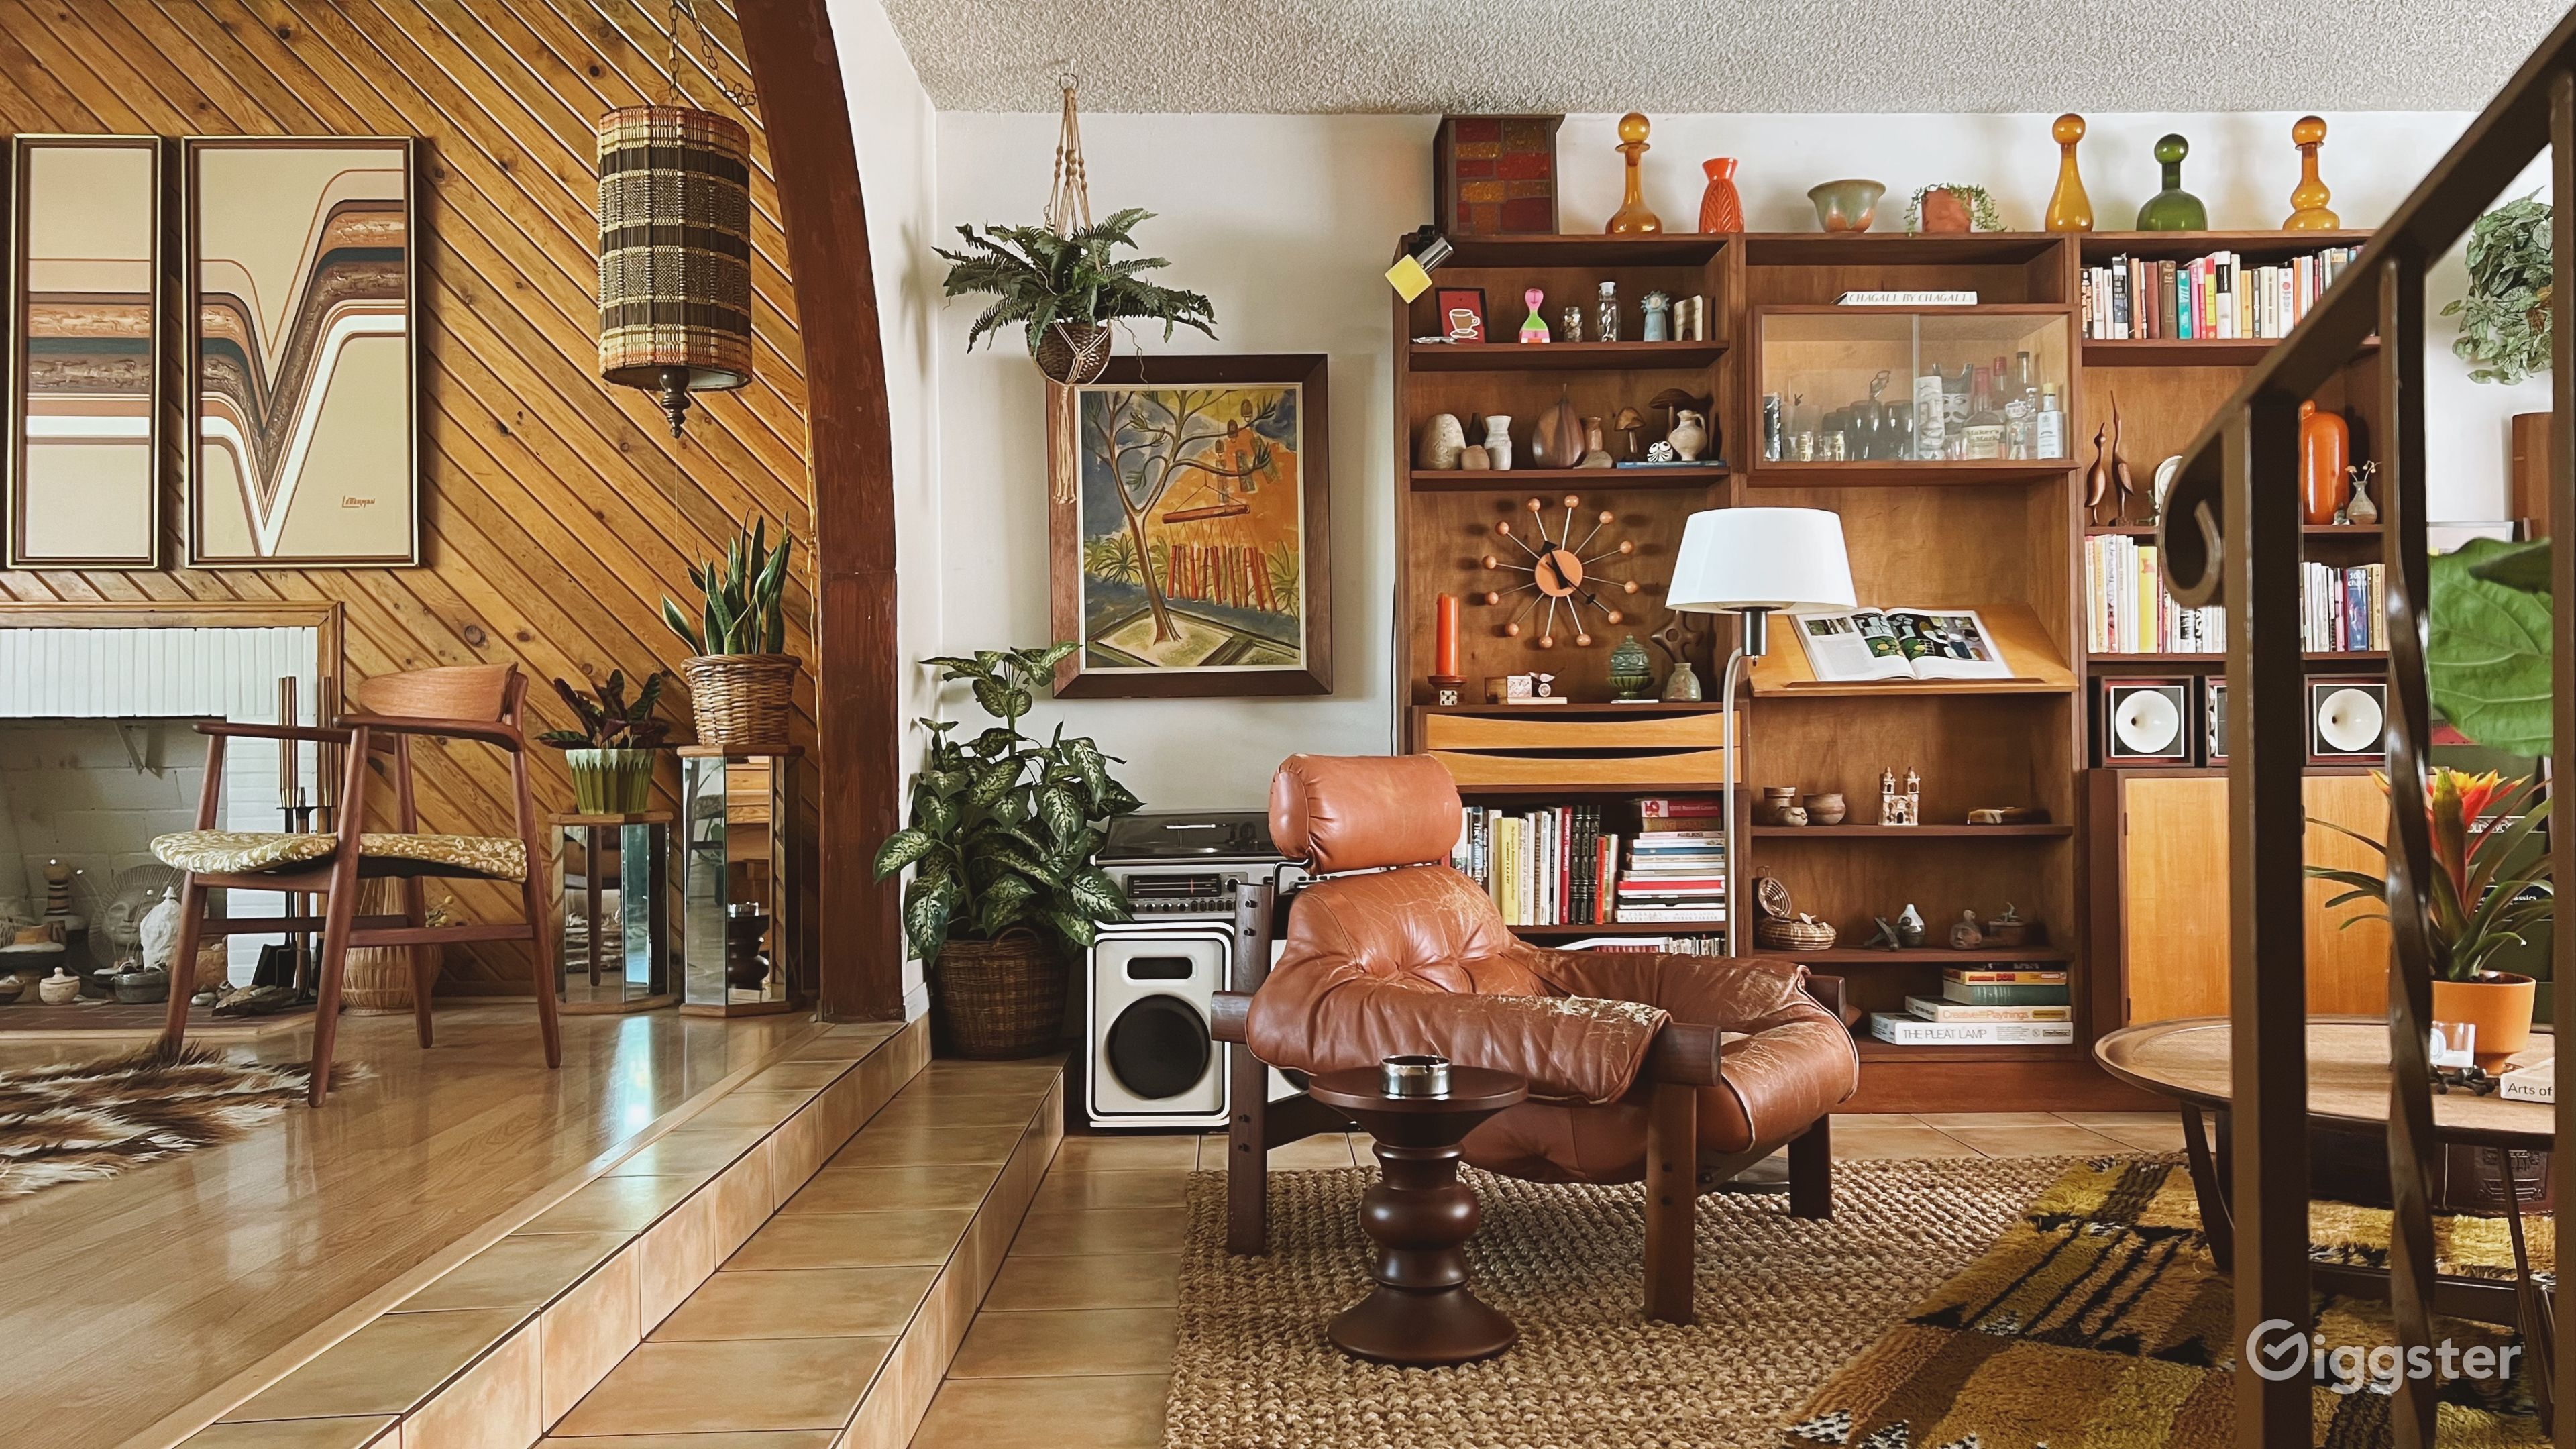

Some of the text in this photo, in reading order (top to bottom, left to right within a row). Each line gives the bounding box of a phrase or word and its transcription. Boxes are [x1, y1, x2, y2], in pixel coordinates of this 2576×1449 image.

[1849, 294, 1968, 302] CHAGALL BY CHAGALL
[1943, 1010, 1976, 1018] Creative
[1986, 1010, 2028, 1020] Playthings
[1902, 1029, 1923, 1039] THE
[1925, 1029, 1956, 1039] PLEAT
[1959, 1029, 1987, 1039] LAMP
[2508, 1083, 2553, 1097] Arts of
